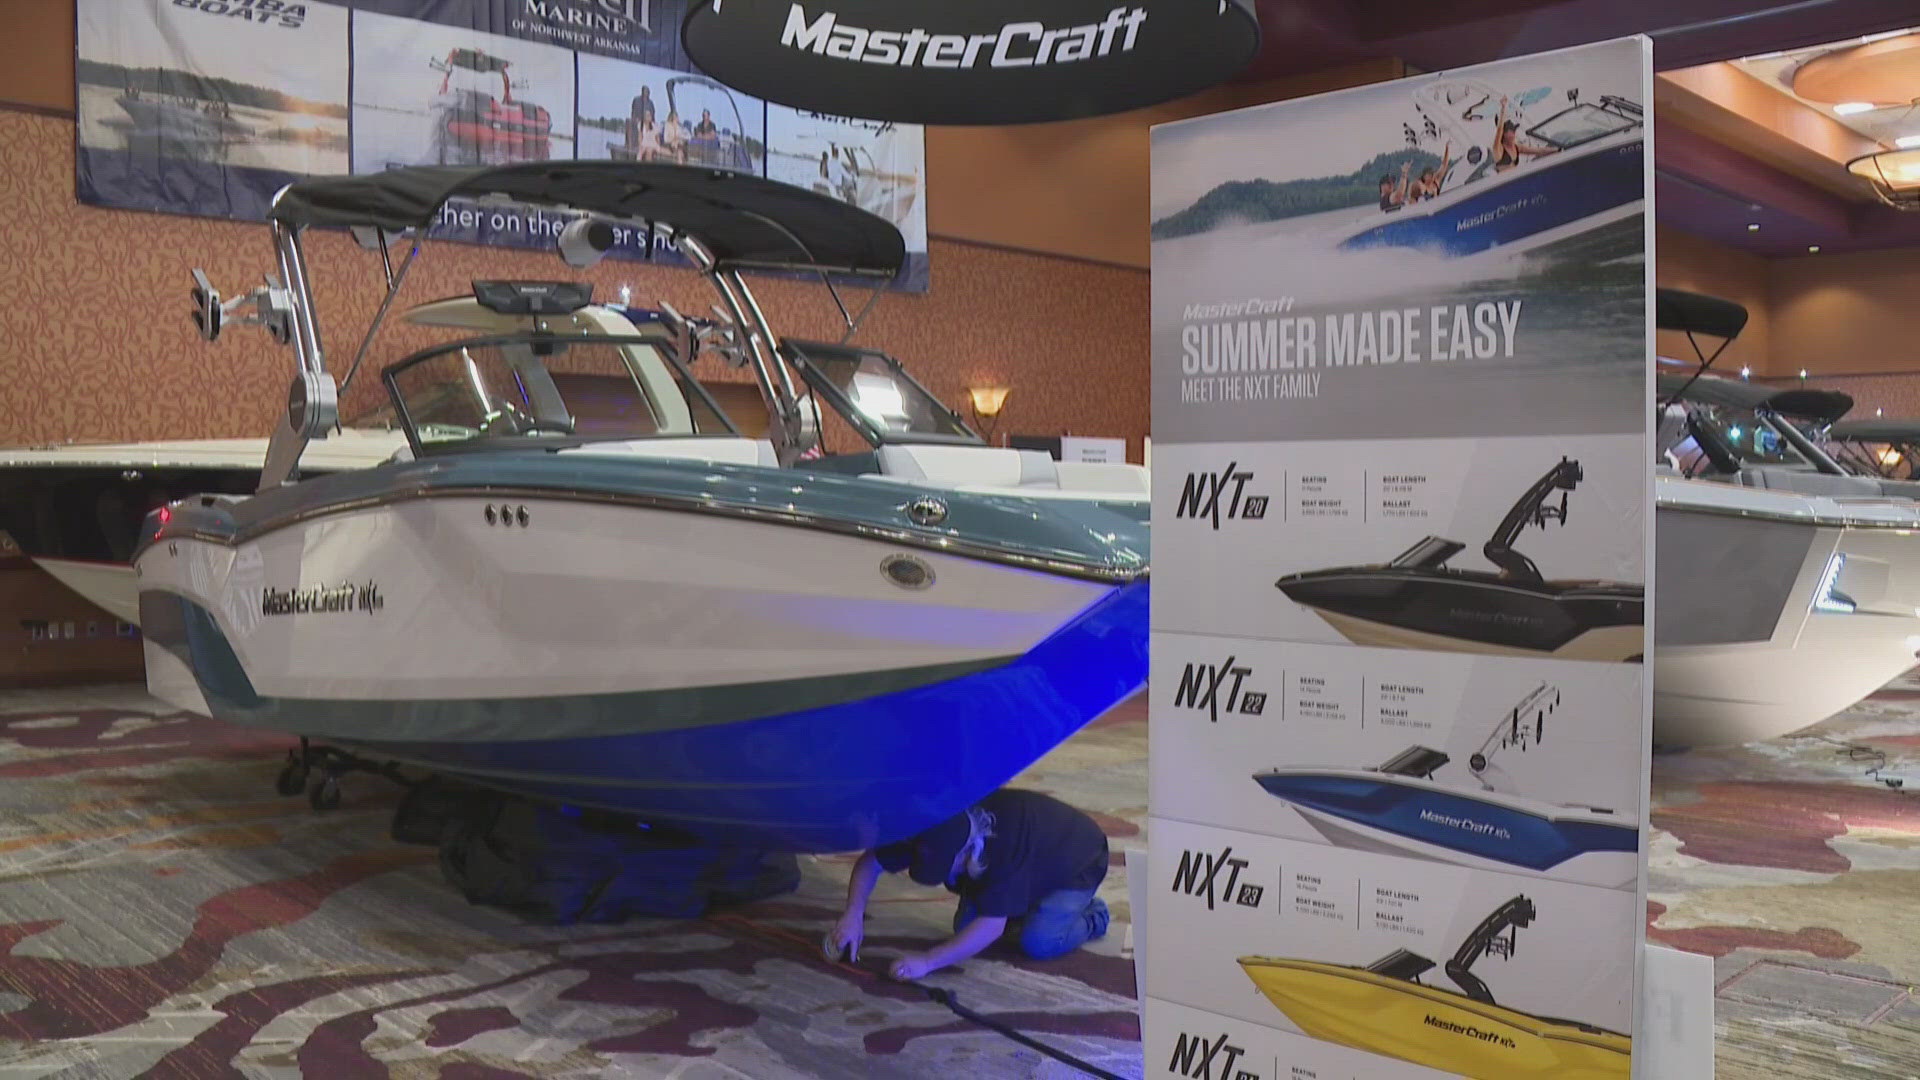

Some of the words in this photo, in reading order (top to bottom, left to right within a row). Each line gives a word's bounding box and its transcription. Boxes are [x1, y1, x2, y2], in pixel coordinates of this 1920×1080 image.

[525, 0, 628, 35] MARINE
[512, 19, 525, 31] OF
[530, 21, 592, 45] NORTHWEST
[594, 38, 641, 55] ARKANSAS
[779, 3, 1149, 69] MasterCraft
[490, 213, 521, 233] on
[527, 210, 564, 236] the
[1183, 295, 1296, 321] MasterCraft
[1181, 316, 1317, 376] SUMMER
[1325, 307, 1421, 368] MADE
[1430, 300, 1522, 361] EASY
[1181, 377, 1216, 403] MEET
[1217, 376, 1242, 401] THE
[1244, 374, 1270, 400] NXT
[1273, 371, 1321, 399] FAMILY
[1419, 808, 1495, 837] MasterCraft
[1423, 1013, 1500, 1045] MasterCraft
